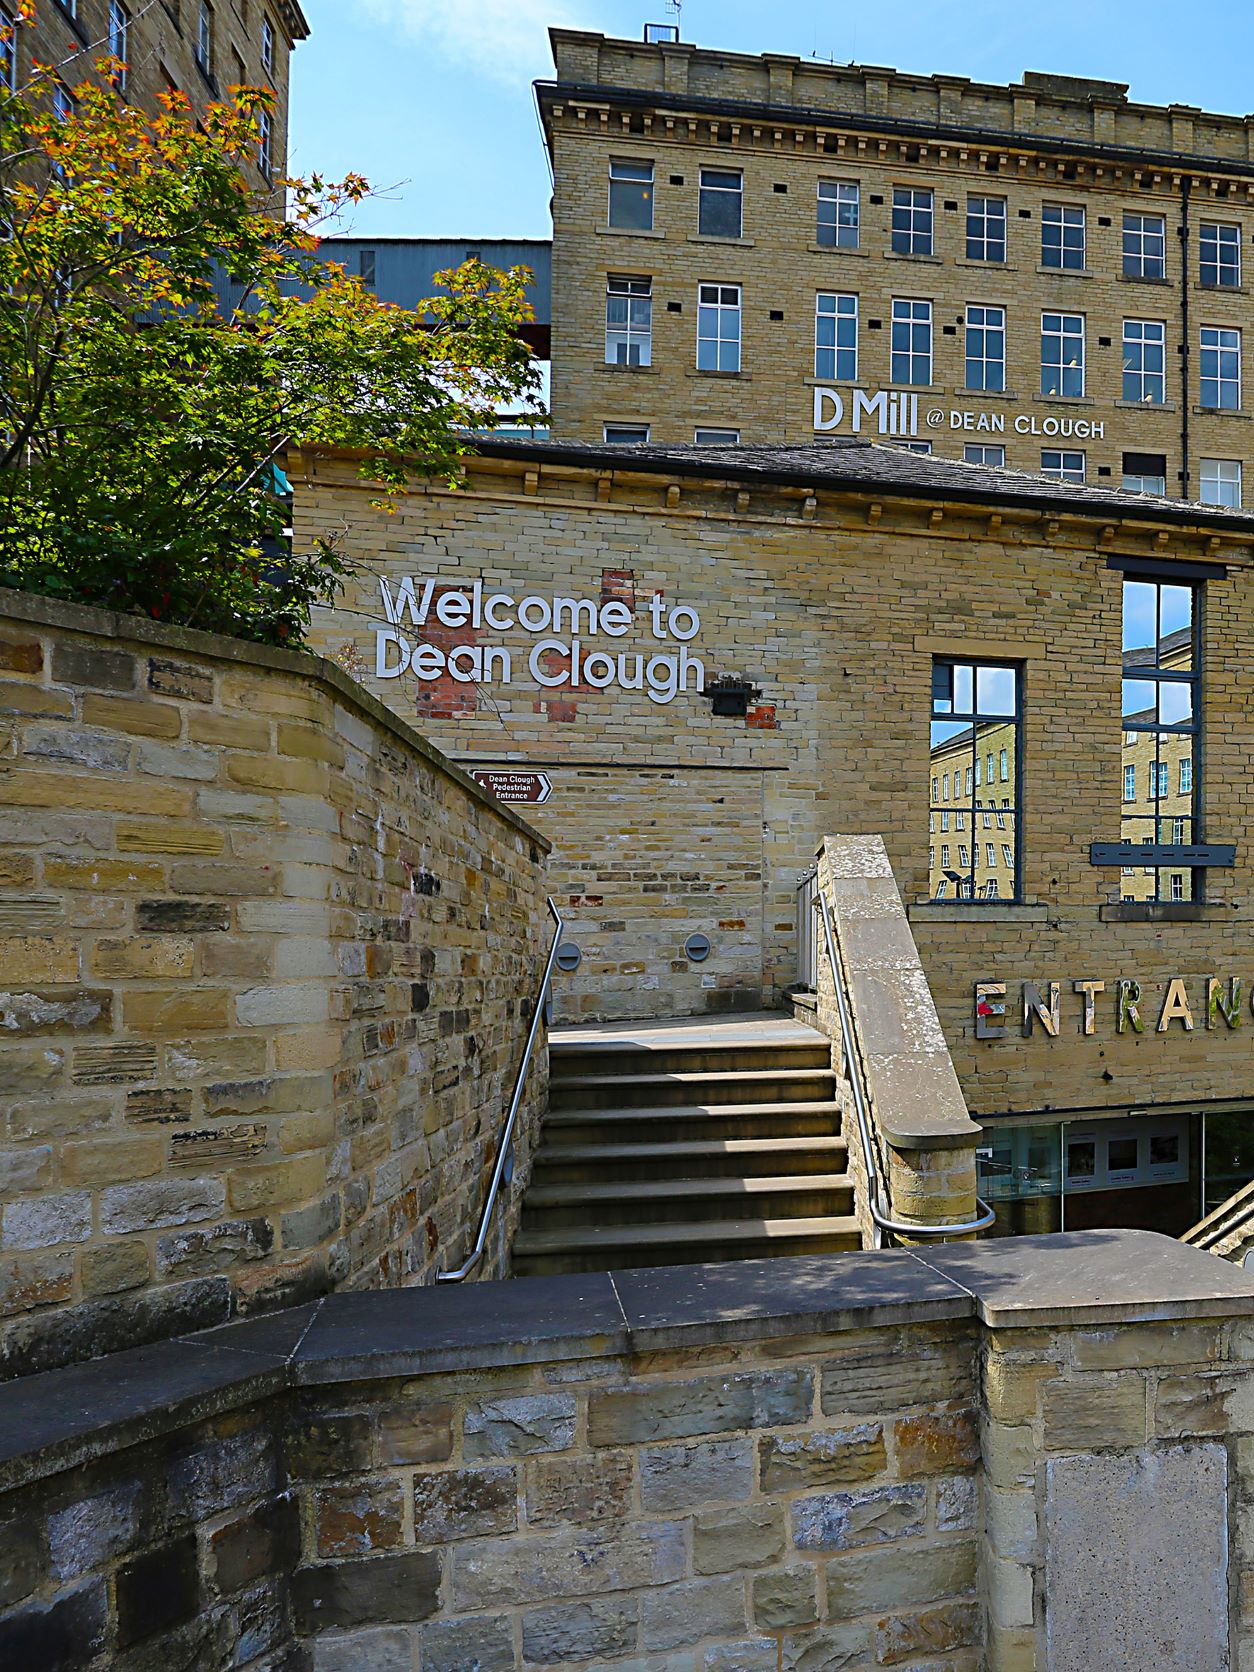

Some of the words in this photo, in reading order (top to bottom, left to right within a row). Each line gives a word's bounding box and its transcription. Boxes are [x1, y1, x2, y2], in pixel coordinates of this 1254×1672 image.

[813, 386, 844, 431] D
[852, 389, 918, 436] Mill
[926, 408, 945, 428] @
[950, 410, 1005, 432] DEAN
[1014, 415, 1105, 439] CLOUGH
[378, 575, 632, 638] Welcome
[649, 593, 700, 641] to
[375, 630, 512, 684] Dean
[528, 638, 705, 705] Clough
[489, 775, 508, 783] Dean
[509, 775, 535, 785] Clough
[493, 783, 531, 792] Pedestrian
[496, 791, 528, 800] Entrance
